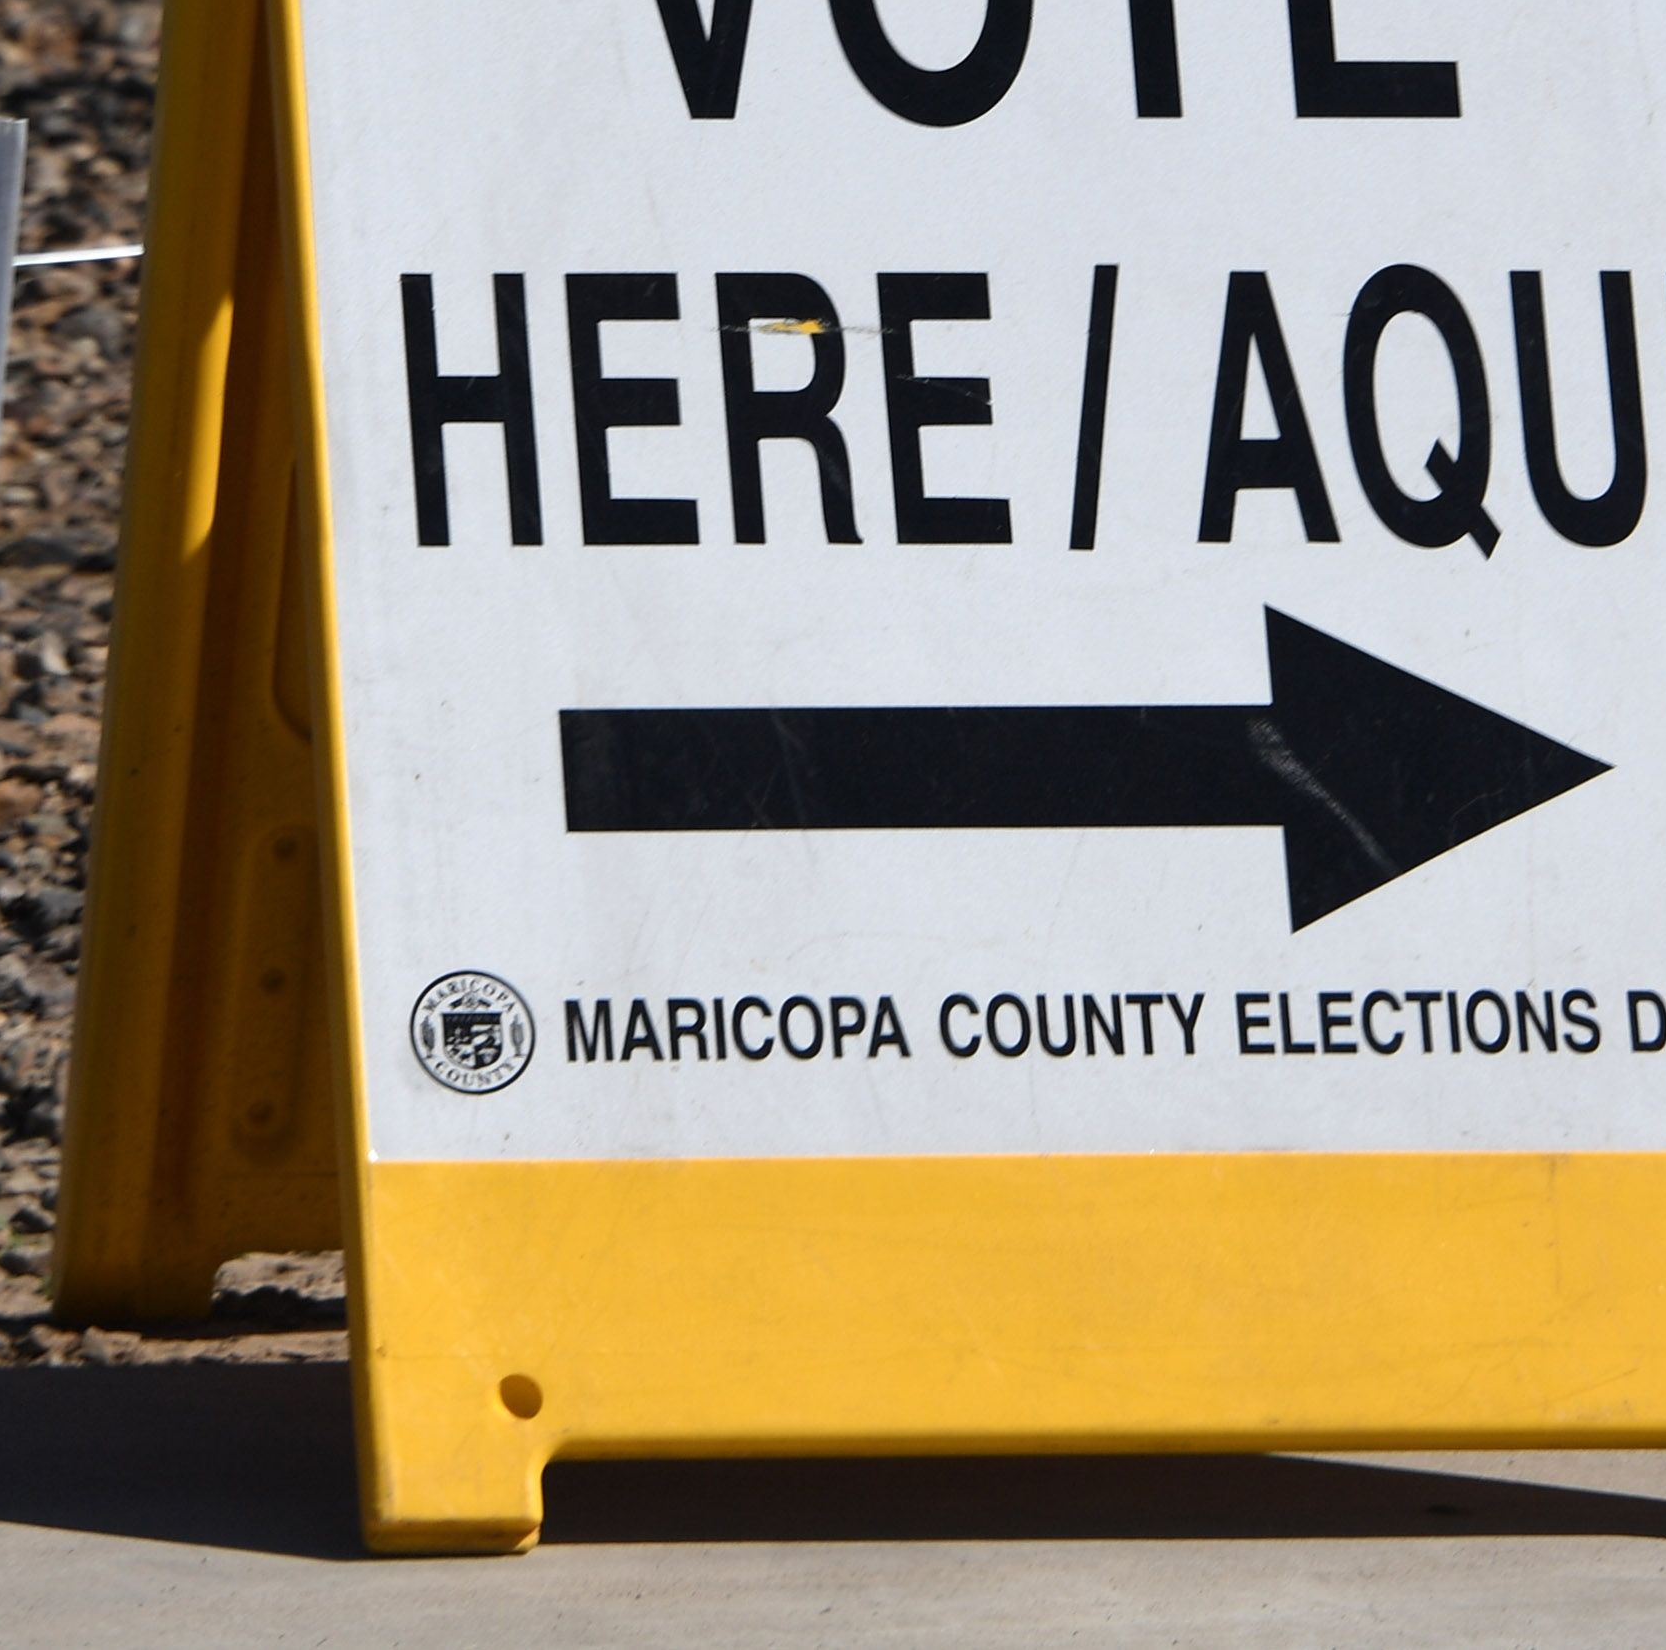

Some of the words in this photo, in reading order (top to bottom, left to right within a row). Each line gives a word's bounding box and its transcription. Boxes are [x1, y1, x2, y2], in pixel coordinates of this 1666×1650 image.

[400, 271, 1012, 547] HERE
[563, 996, 910, 1062] MARICOPA
[939, 993, 1204, 1057] COUNTY
[1235, 989, 1600, 1054] ELECTIONS
